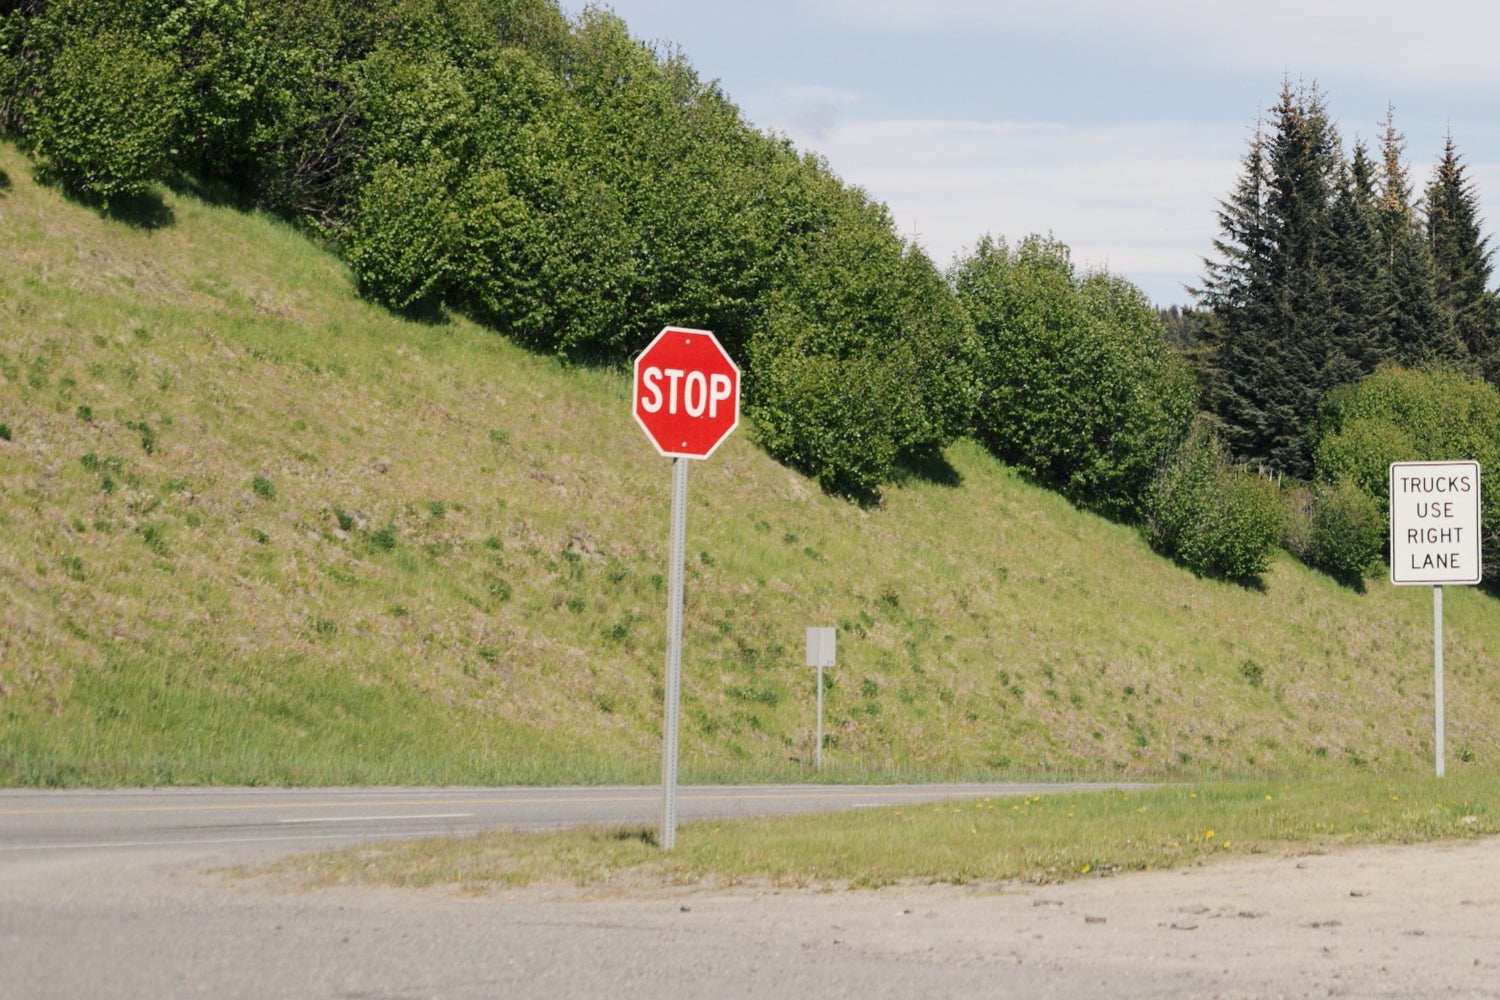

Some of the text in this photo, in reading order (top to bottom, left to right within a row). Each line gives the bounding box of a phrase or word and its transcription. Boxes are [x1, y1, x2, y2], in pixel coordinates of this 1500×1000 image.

[641, 366, 732, 418] STOP
[1400, 476, 1471, 493] TRUCKS
[1416, 502, 1454, 518] USE
[1407, 527, 1463, 544] RIGHT
[1411, 553, 1460, 569] LANE
